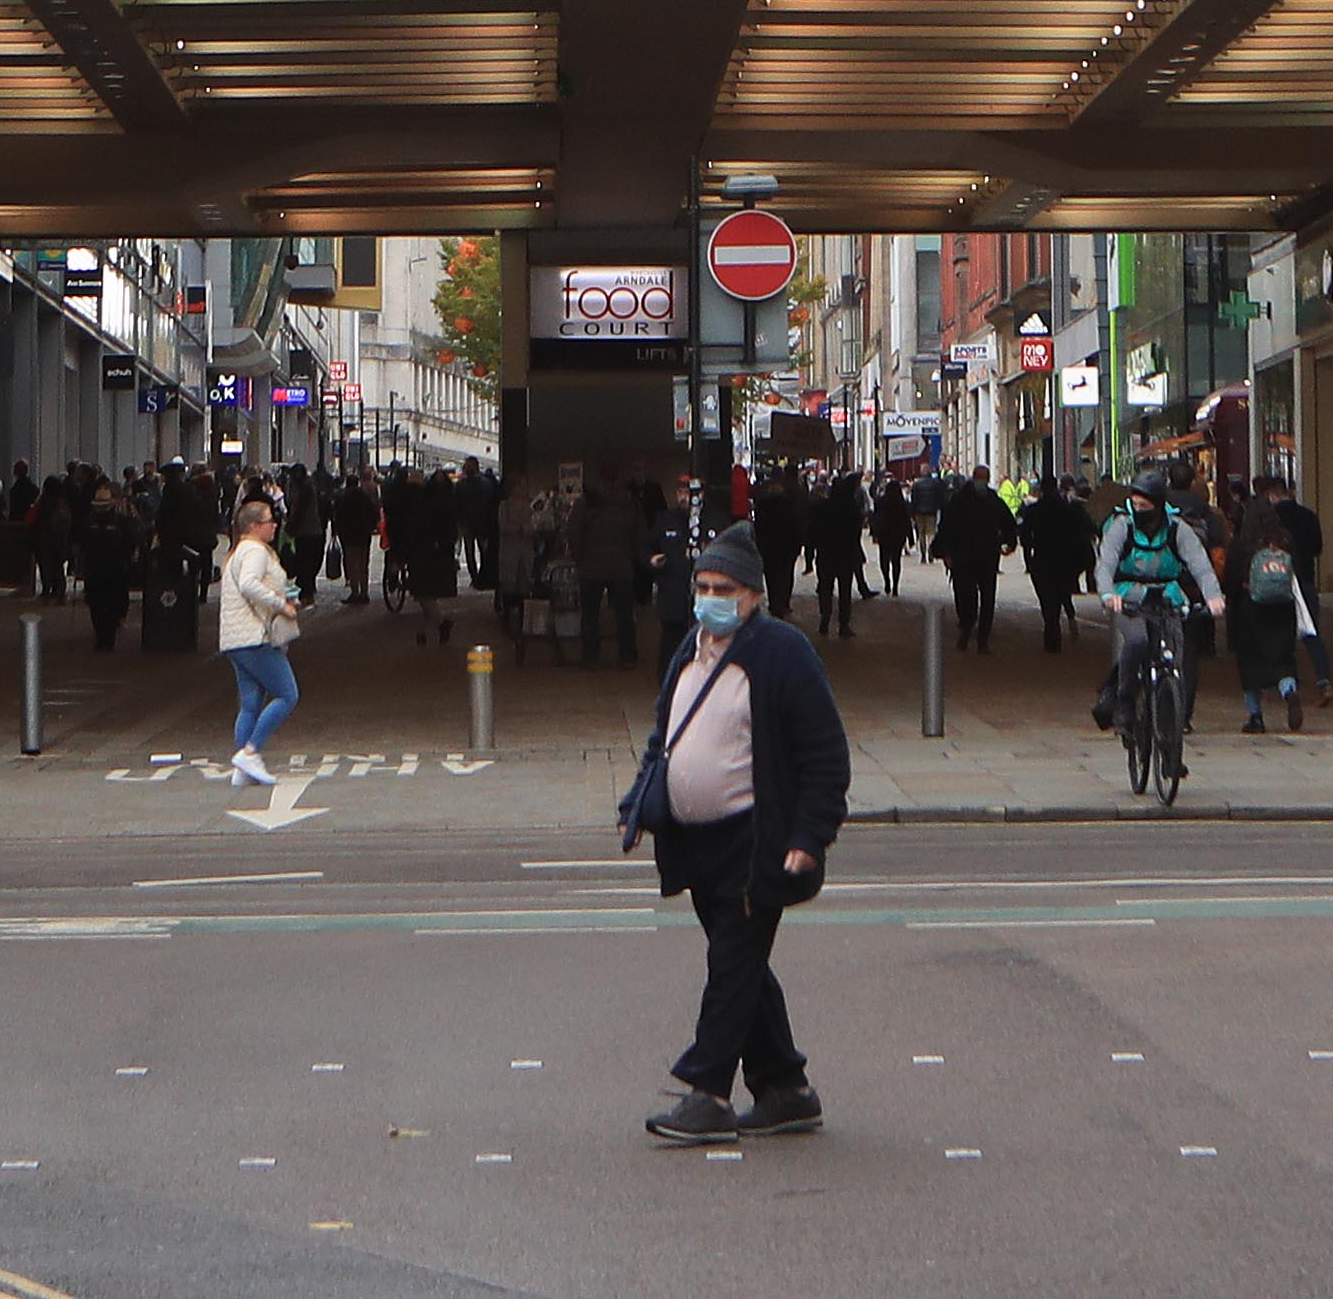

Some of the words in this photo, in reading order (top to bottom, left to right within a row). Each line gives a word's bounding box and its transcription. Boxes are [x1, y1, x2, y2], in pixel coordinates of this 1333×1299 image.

[615, 276, 667, 286] ARNDALE
[562, 270, 674, 319] food
[559, 322, 674, 336] COURT
